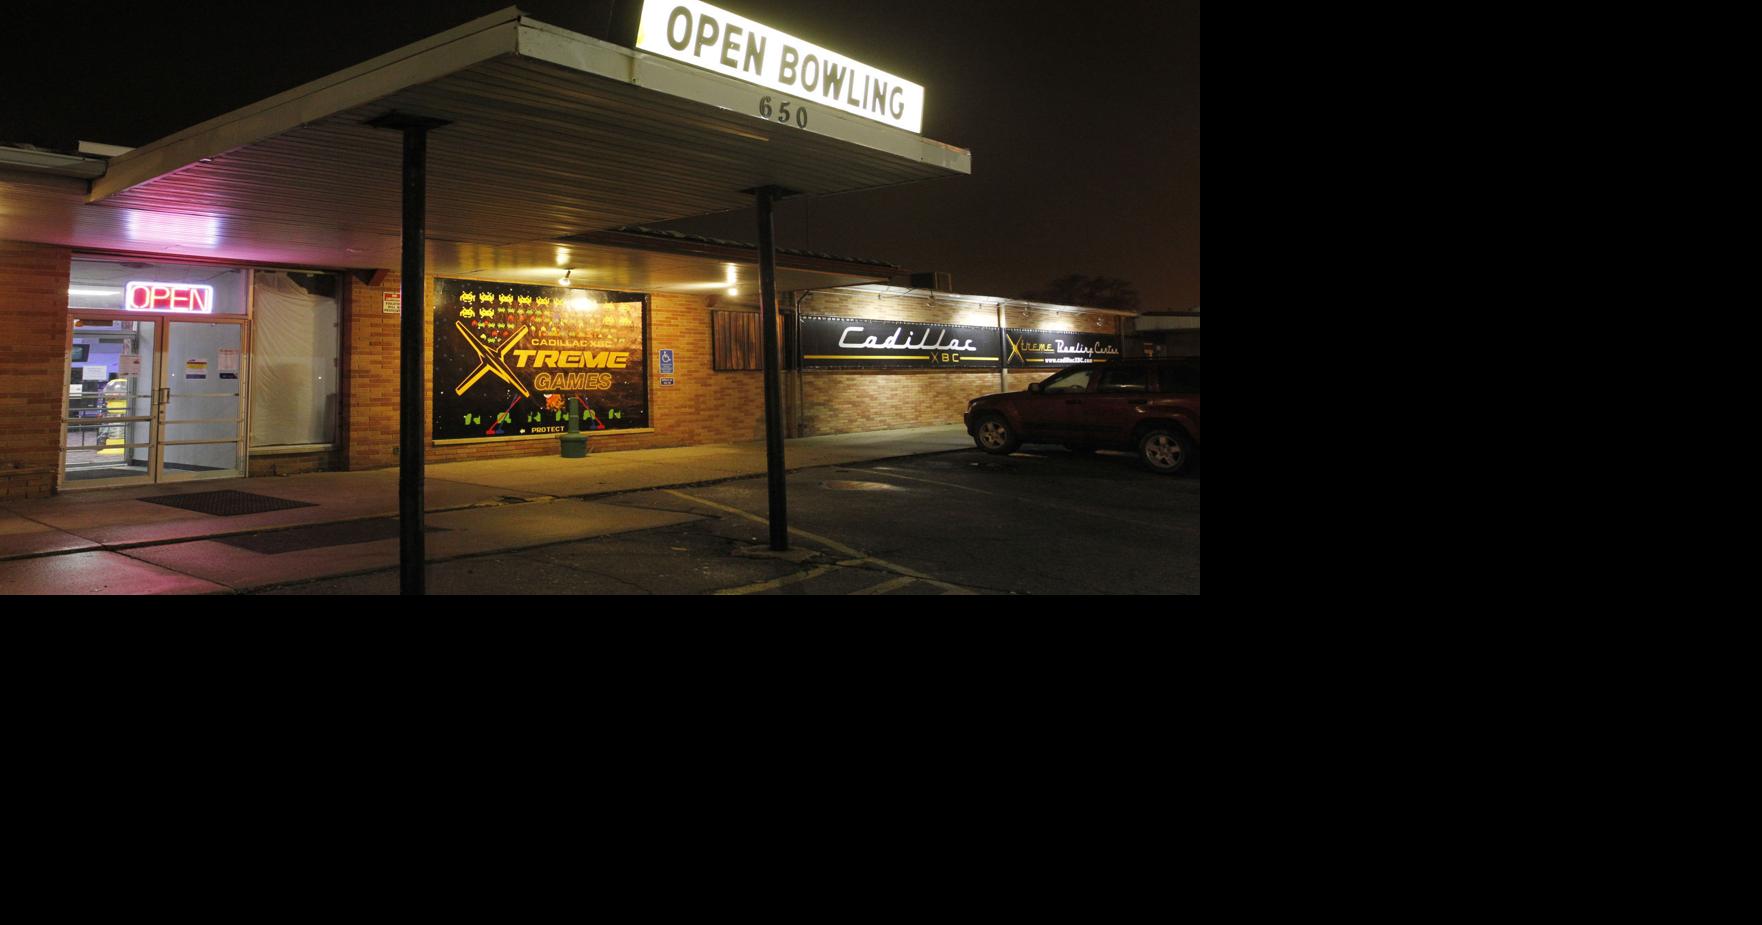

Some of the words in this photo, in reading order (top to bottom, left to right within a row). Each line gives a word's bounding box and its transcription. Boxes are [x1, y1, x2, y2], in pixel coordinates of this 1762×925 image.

[667, 5, 767, 77] OPEN
[778, 44, 905, 121] BOWLING
[758, 95, 808, 129] 650
[130, 285, 210, 312] OPEN
[531, 338, 588, 348] CADILLAC
[839, 327, 976, 350] Cadillac
[930, 353, 959, 362] XBC
[534, 372, 612, 390] GAMES
[531, 425, 565, 434] PROTECT
